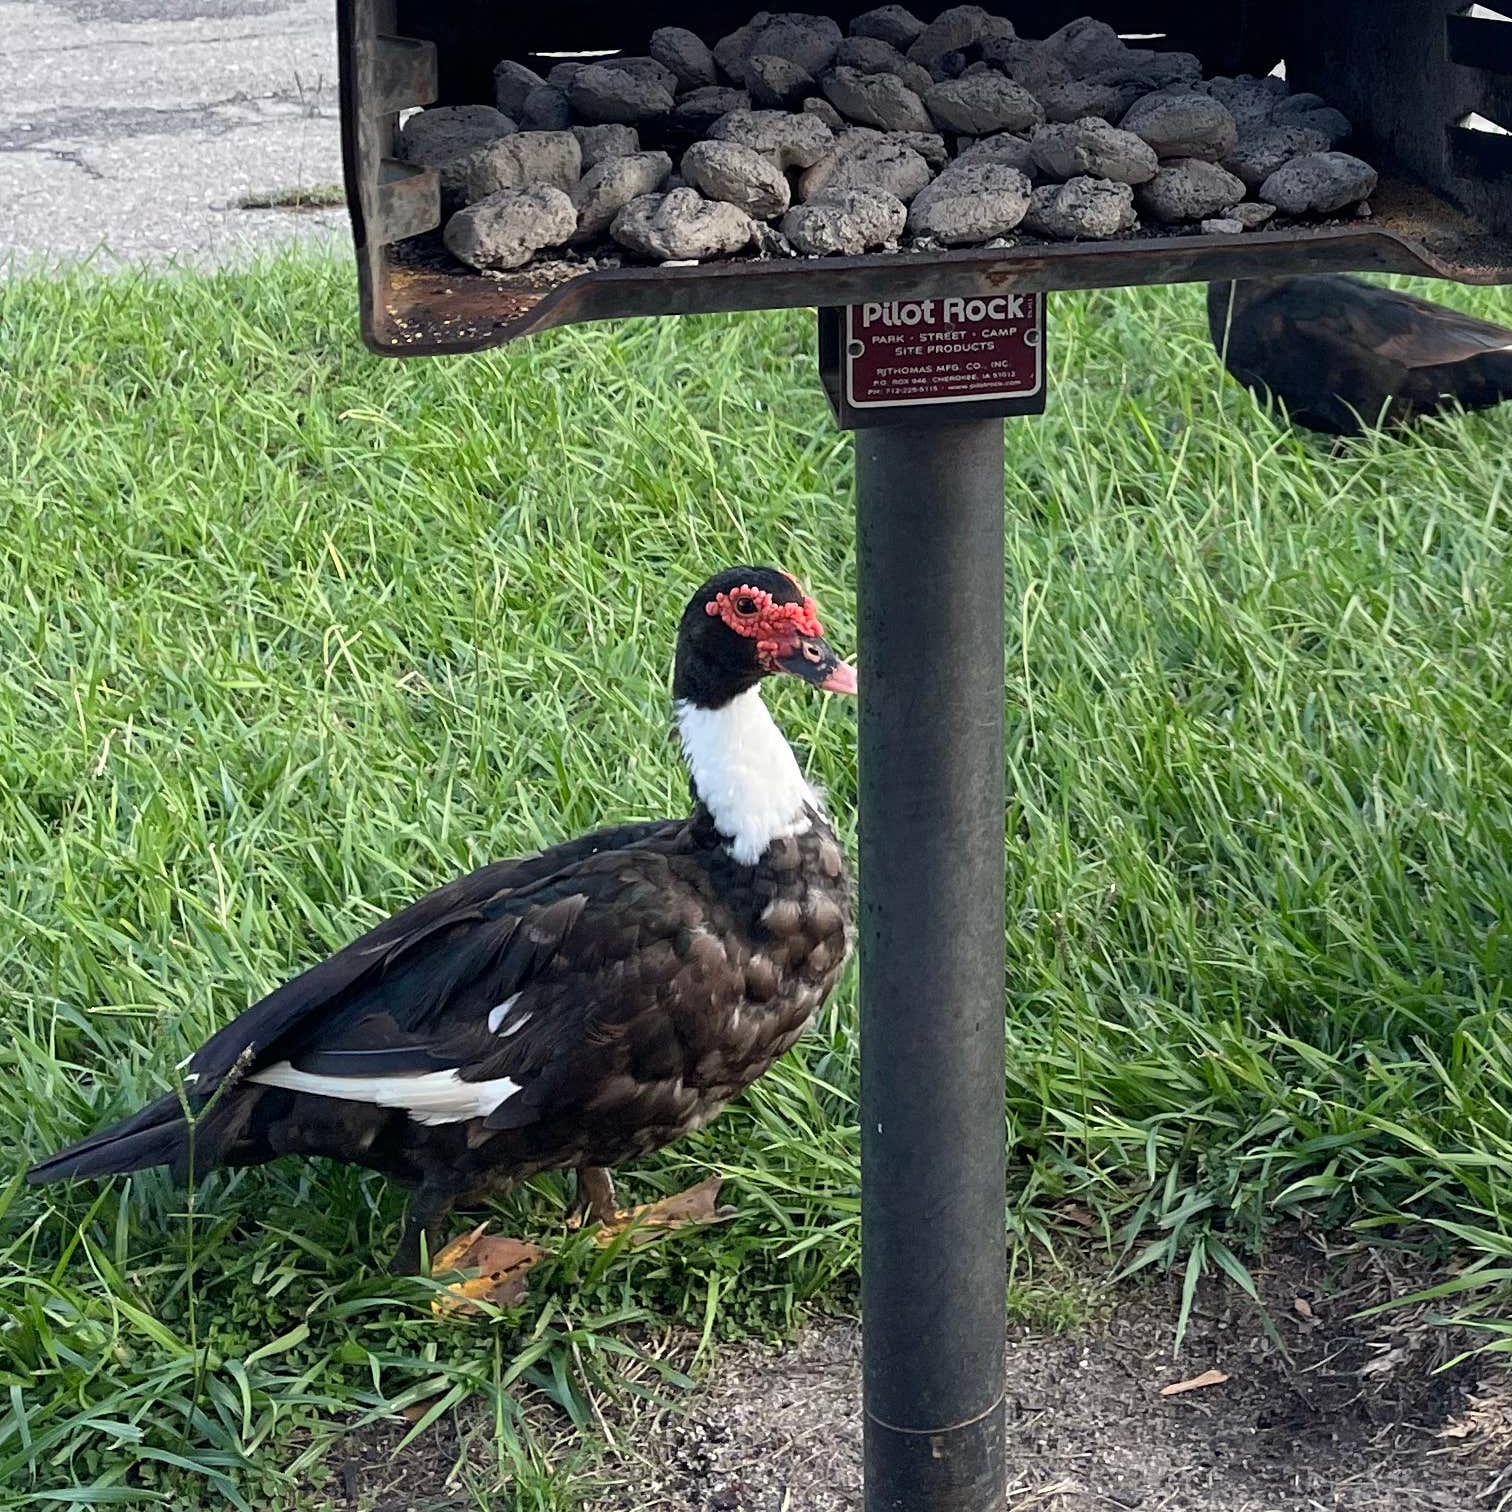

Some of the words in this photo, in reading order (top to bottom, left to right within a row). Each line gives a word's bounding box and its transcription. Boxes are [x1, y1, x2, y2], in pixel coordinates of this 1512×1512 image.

[863, 299, 935, 328] Pilot
[944, 293, 1025, 323] Rock
[872, 335, 905, 344] PARK
[920, 330, 967, 342] STREET
[981, 327, 1017, 338] CAMP
[895, 346, 923, 356] SITE
[927, 341, 995, 354] PRODUCTS
